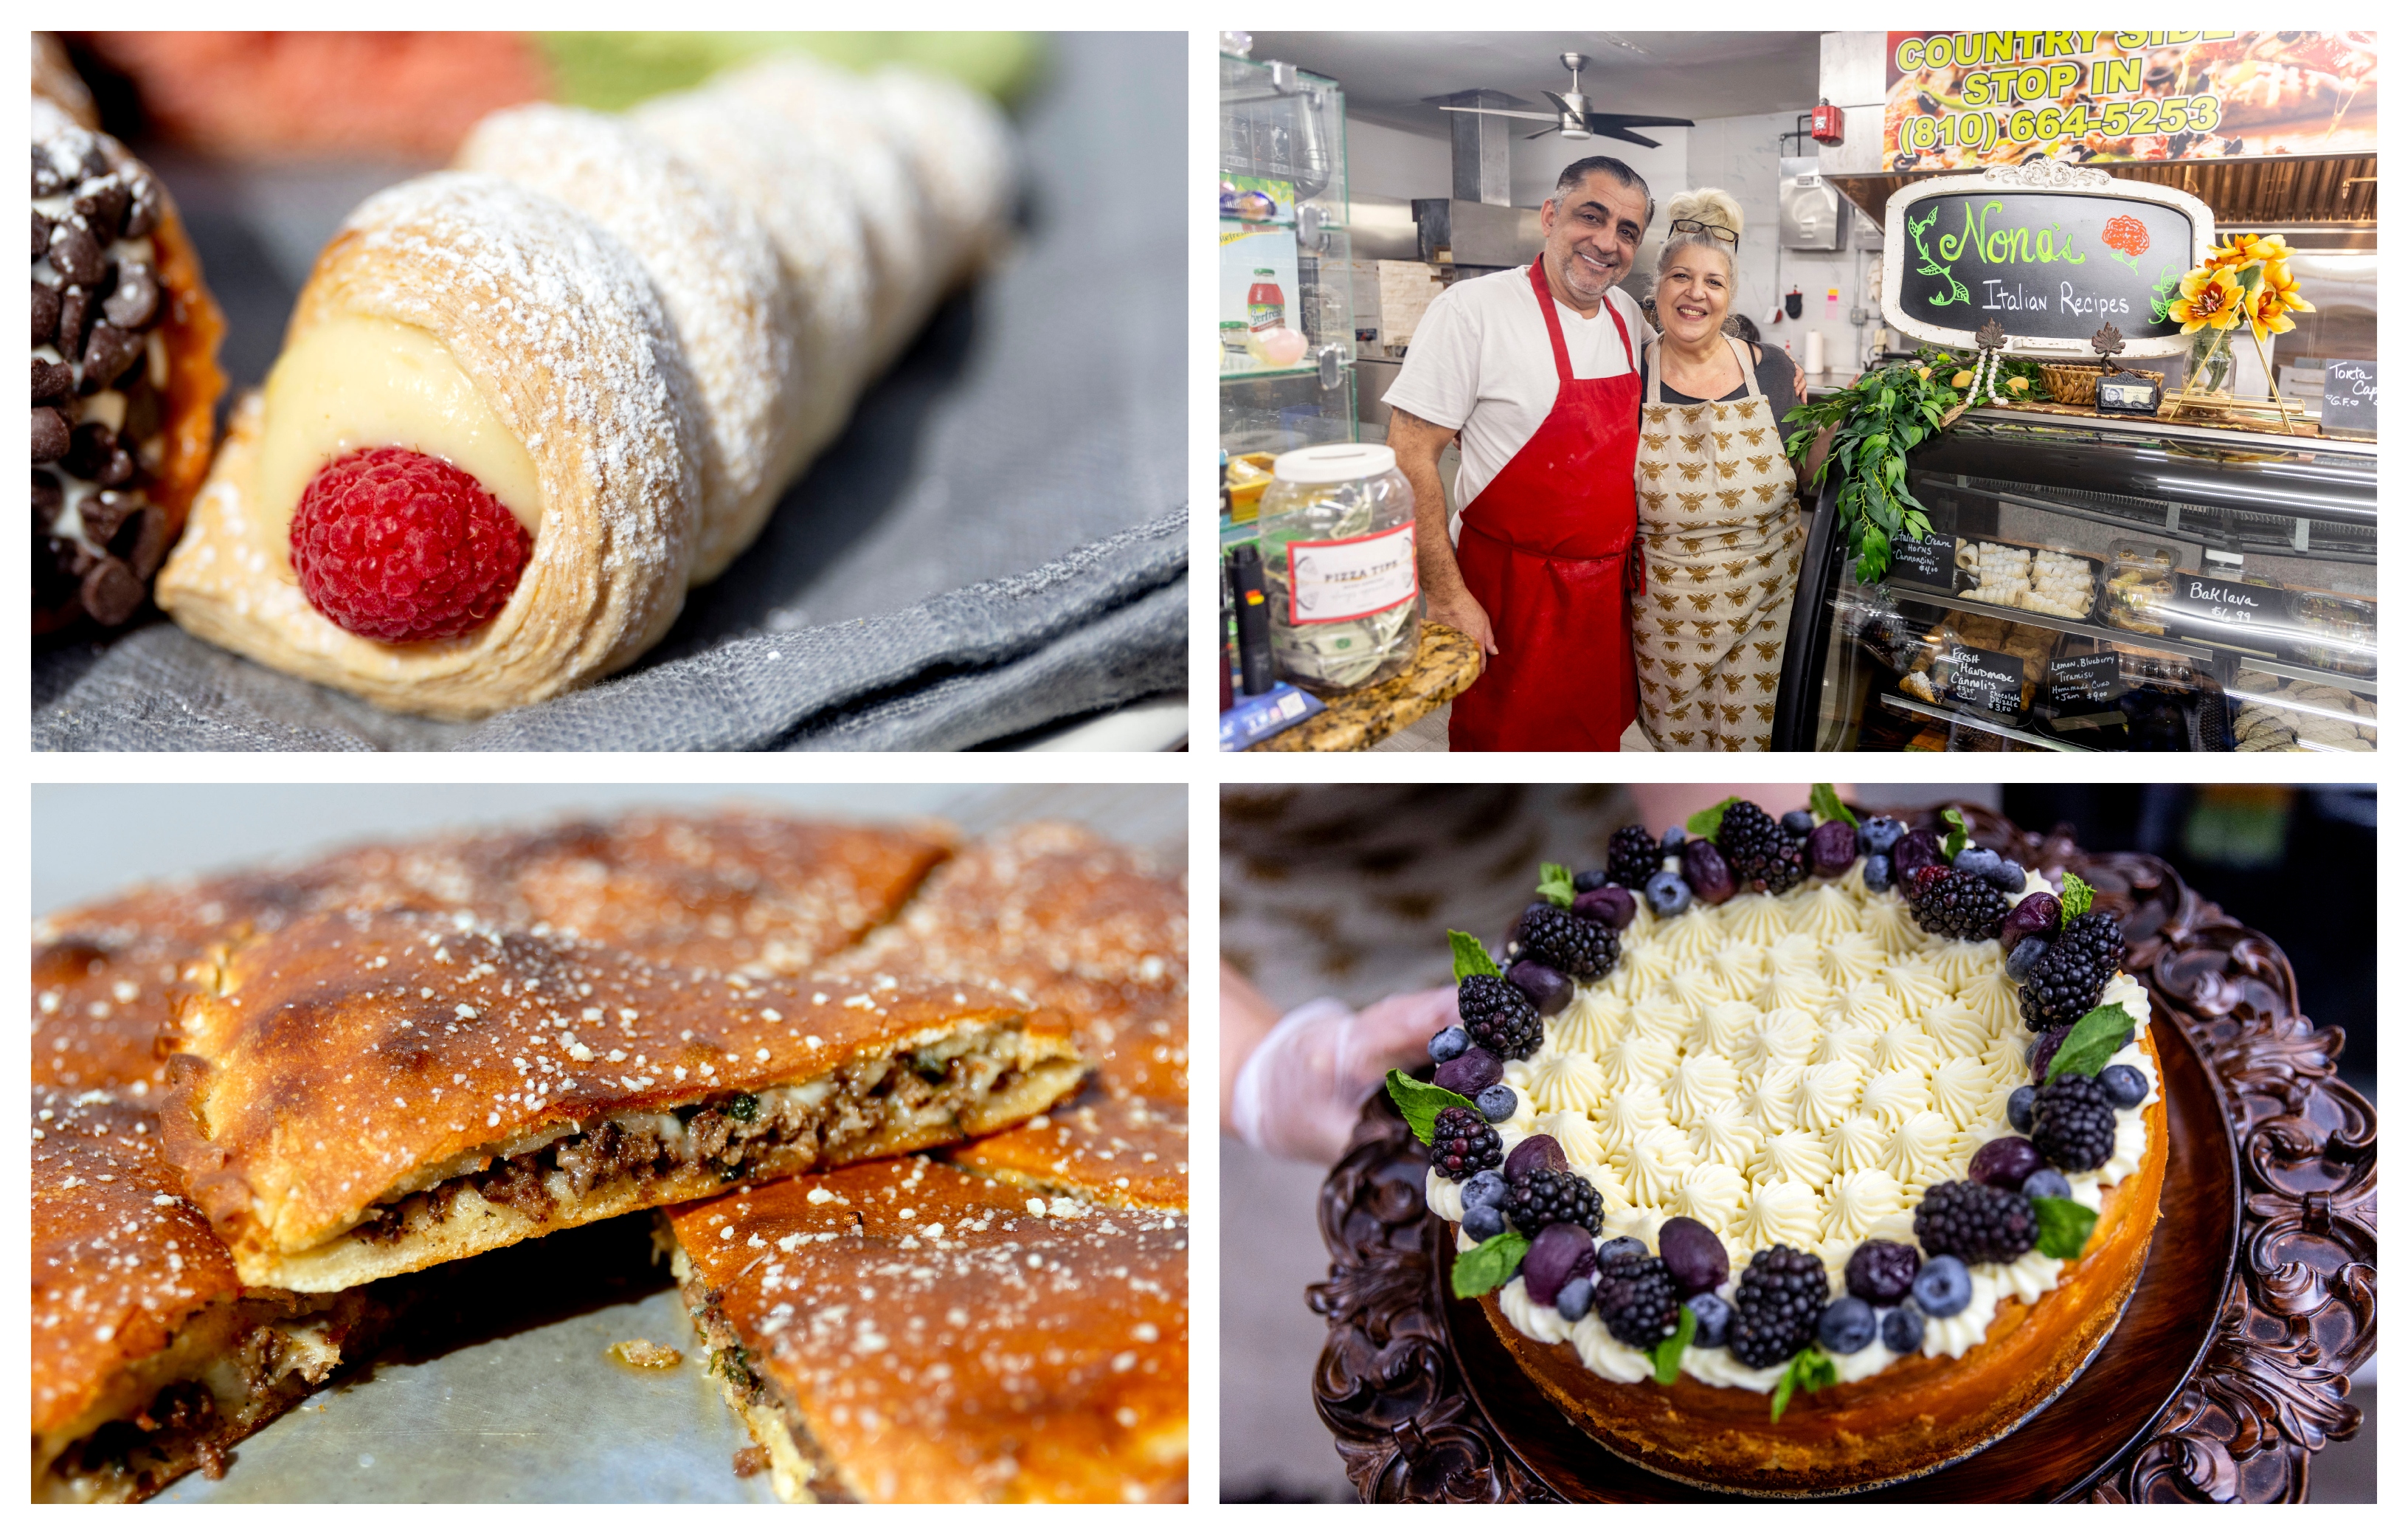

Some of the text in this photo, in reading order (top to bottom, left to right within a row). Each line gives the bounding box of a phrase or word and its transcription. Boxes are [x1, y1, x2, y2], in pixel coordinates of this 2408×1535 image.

[1897, 31, 2100, 72] COUNTRY
[1963, 56, 2143, 106] STOP IN
[1900, 94, 2220, 156] (810) 664-5253
[1939, 200, 2086, 265] Nona's
[1982, 279, 2130, 318] Italian Recipes
[2328, 362, 2373, 380] Torta
[1924, 534, 1952, 548] Cream
[1324, 569, 1367, 584] PIZZA
[1919, 565, 1938, 575] $4.00
[2190, 582, 2259, 607] Baklava
[2080, 655, 2114, 667] Blueberry
[1950, 672, 1996, 691] Cannoli's
[2056, 671, 2094, 683] Tiramisu
[2052, 683, 2089, 694] Homemade
[2061, 692, 2080, 702] Jam
[2086, 691, 2108, 702] $9.00
